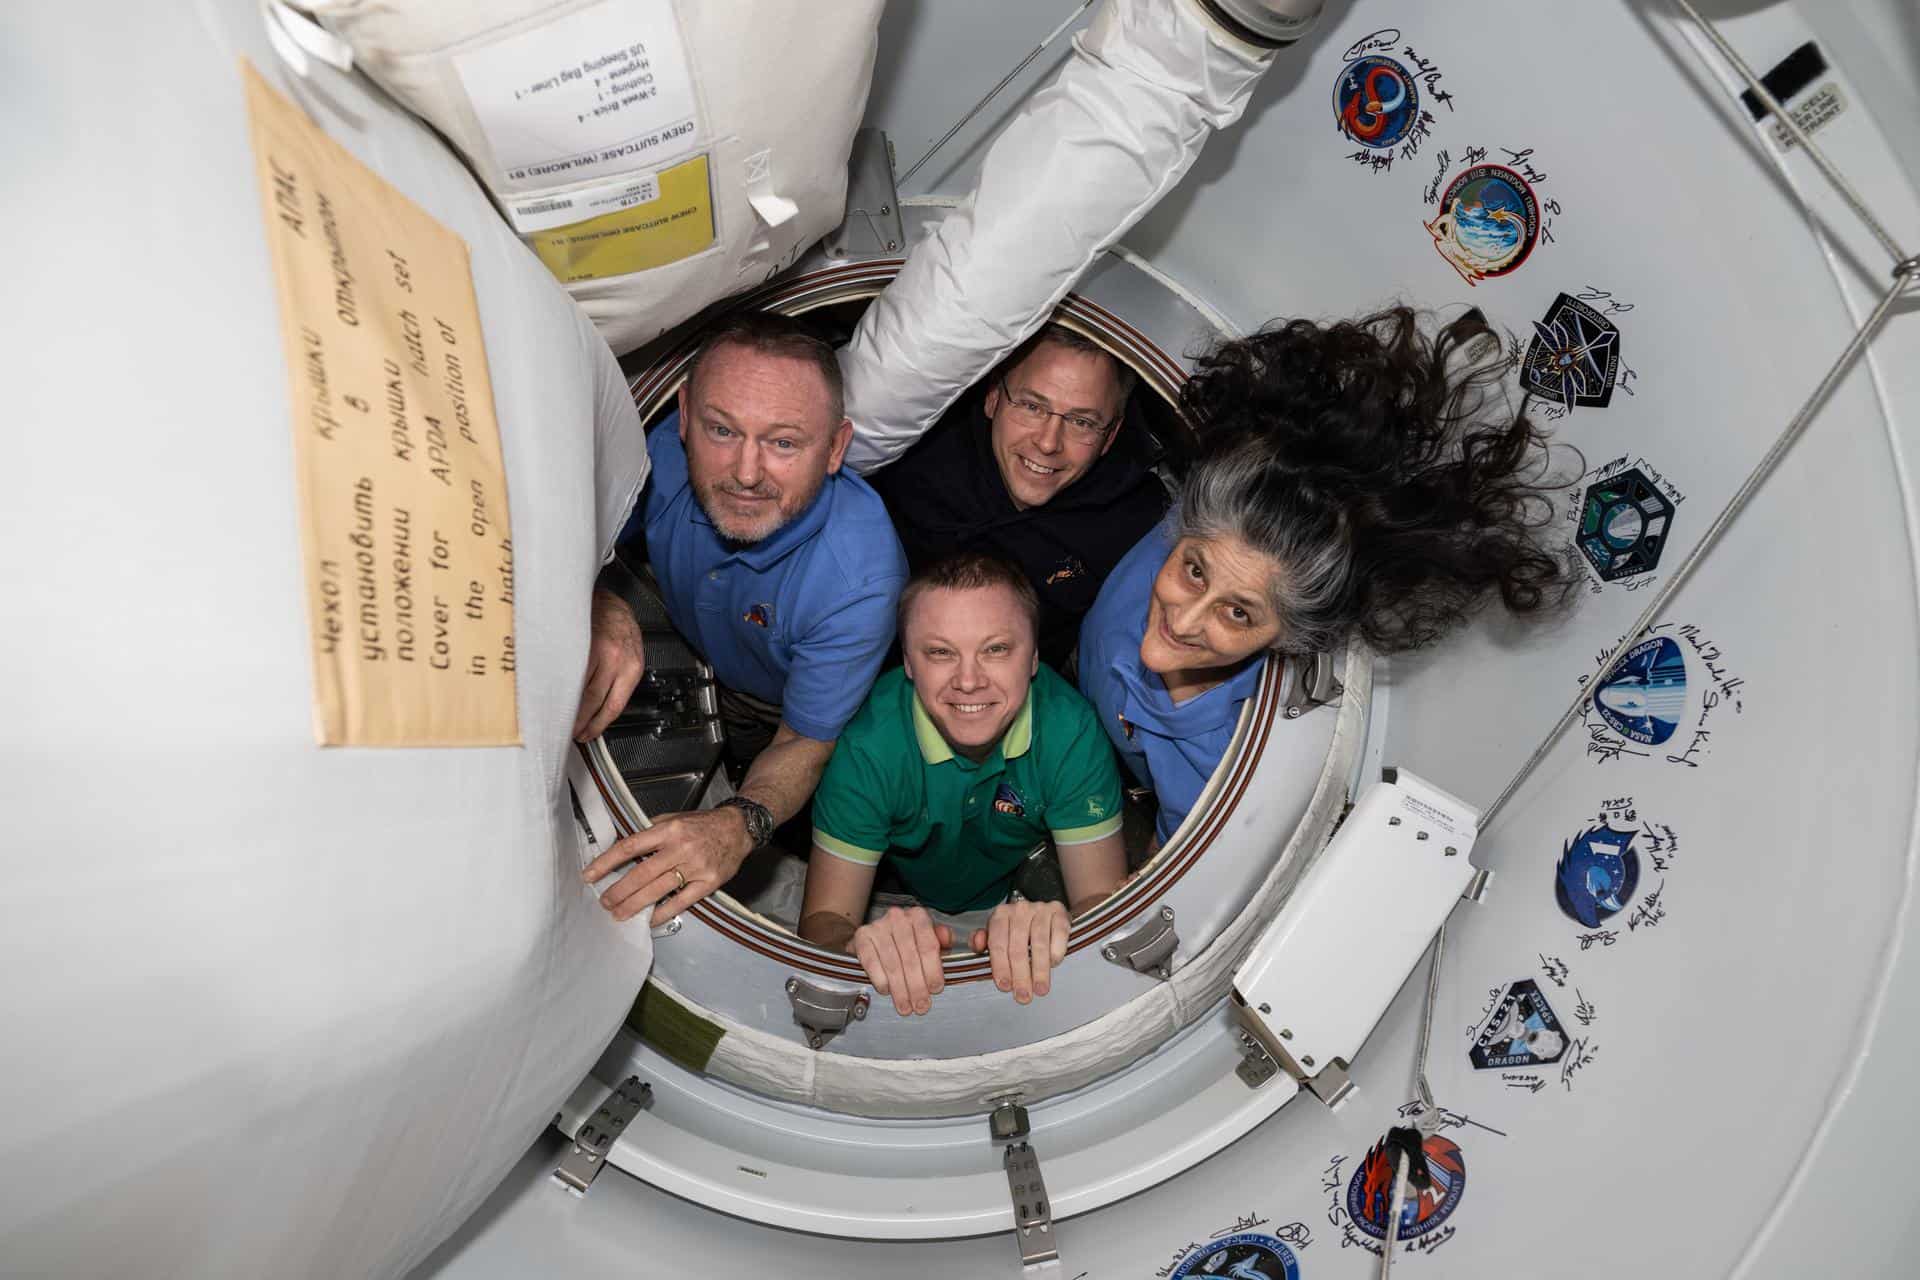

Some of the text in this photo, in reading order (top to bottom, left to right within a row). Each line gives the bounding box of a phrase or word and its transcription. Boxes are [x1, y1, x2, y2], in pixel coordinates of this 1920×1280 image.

[630, 43, 646, 57] US
[583, 51, 629, 73] Sleeping
[609, 58, 649, 80] Hygiene
[531, 76, 561, 93] Liner
[561, 67, 583, 83] Bag
[611, 72, 654, 93] Clothing
[625, 86, 657, 105] 2-Week
[594, 101, 620, 117] Brick
[508, 121, 695, 181] CREW SUITCASE (WILMORE) B1
[623, 215, 670, 235] SUITCASE
[671, 205, 697, 223] CREW
[267, 153, 344, 654] Чехол крышки АПАС
[315, 190, 388, 662] установить в открытом
[385, 248, 452, 672] Cover for APDA hatch set
[433, 316, 491, 677] in the open position of
[384, 357, 415, 662] положении крышки
[499, 635, 516, 674] the
[1629, 638, 1665, 660] DRAGON
[1487, 1055, 1530, 1066] DRAGON
